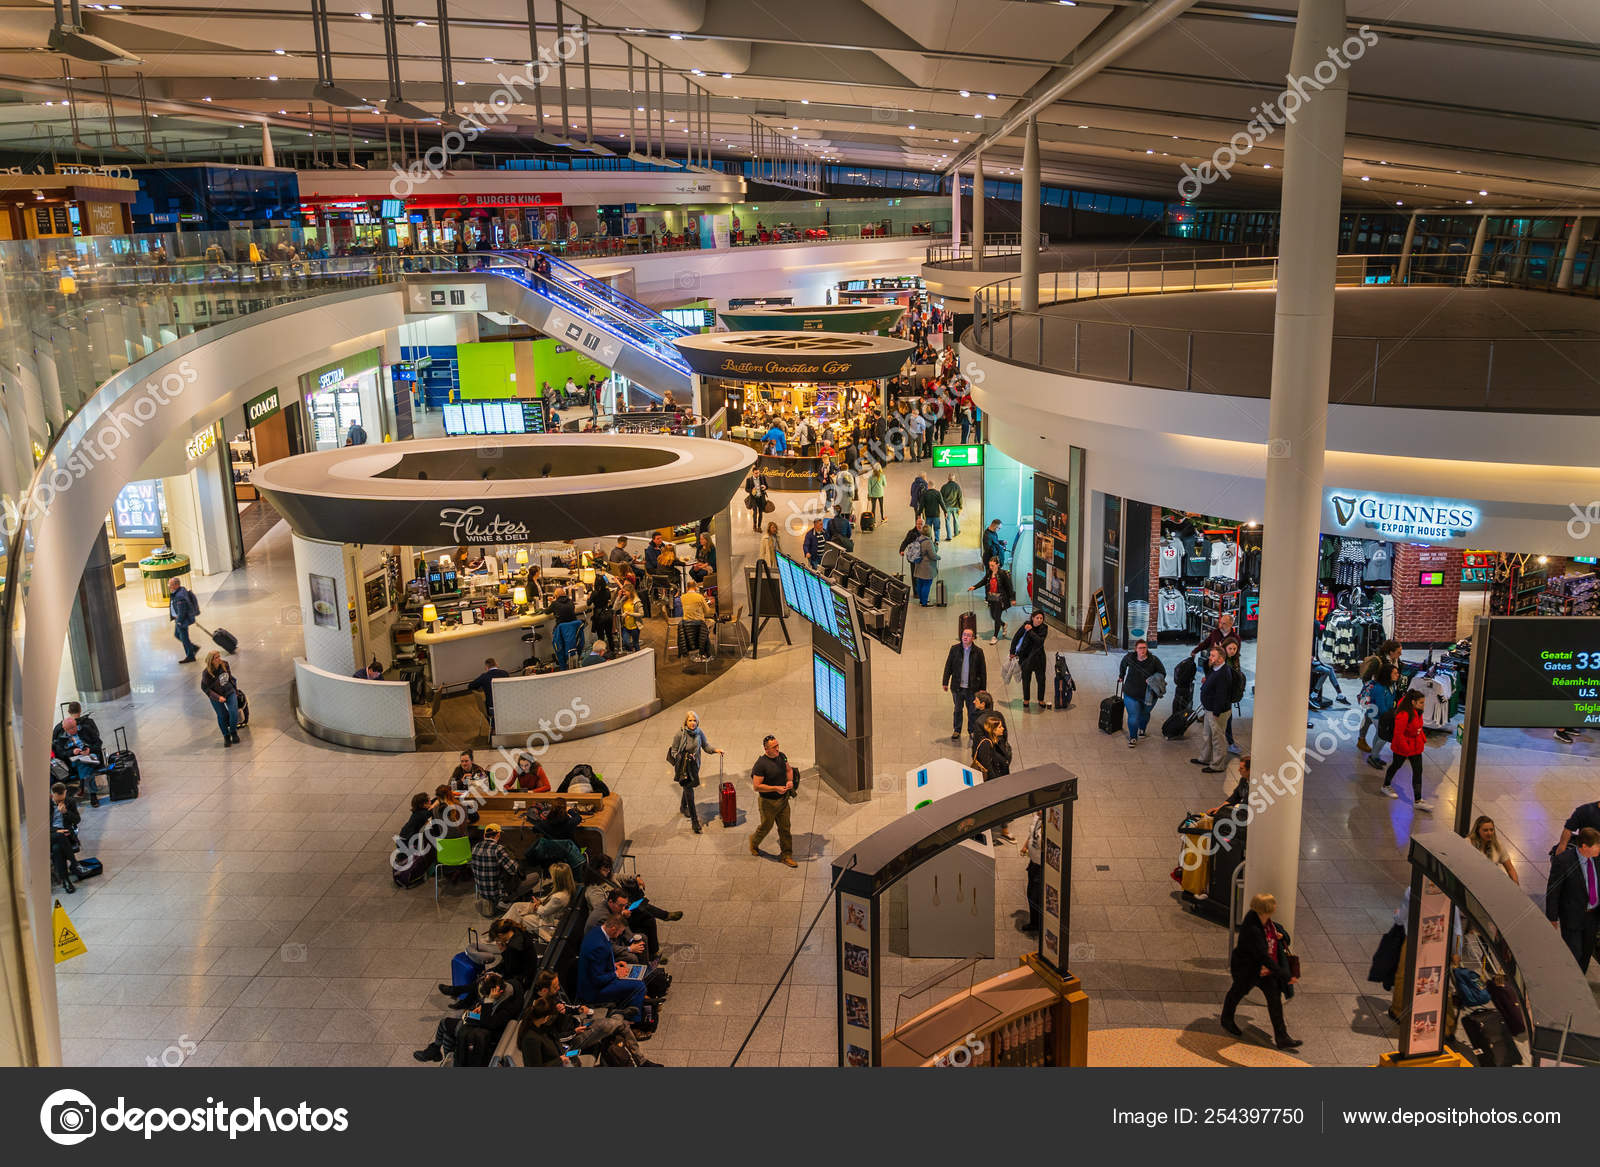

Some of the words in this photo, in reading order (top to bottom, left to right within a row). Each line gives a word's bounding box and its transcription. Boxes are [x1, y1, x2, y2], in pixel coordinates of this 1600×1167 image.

[476, 195, 516, 205] BURGER
[518, 194, 541, 204] KING
[720, 359, 763, 374] Butlers
[765, 361, 819, 373] Chocolate
[822, 360, 851, 374] Café
[319, 367, 345, 389] SPECTRUM
[250, 393, 278, 420] COACH
[1359, 499, 1473, 527] GUINNESS
[440, 505, 530, 543] Flutes
[1382, 523, 1414, 535] EXPORT
[1418, 526, 1447, 537] HOUSE
[1540, 651, 1573, 660] Geataí
[1544, 661, 1572, 671] Gates
[1552, 677, 1600, 686] Réamh-Im
[1578, 688, 1598, 697] U.S.
